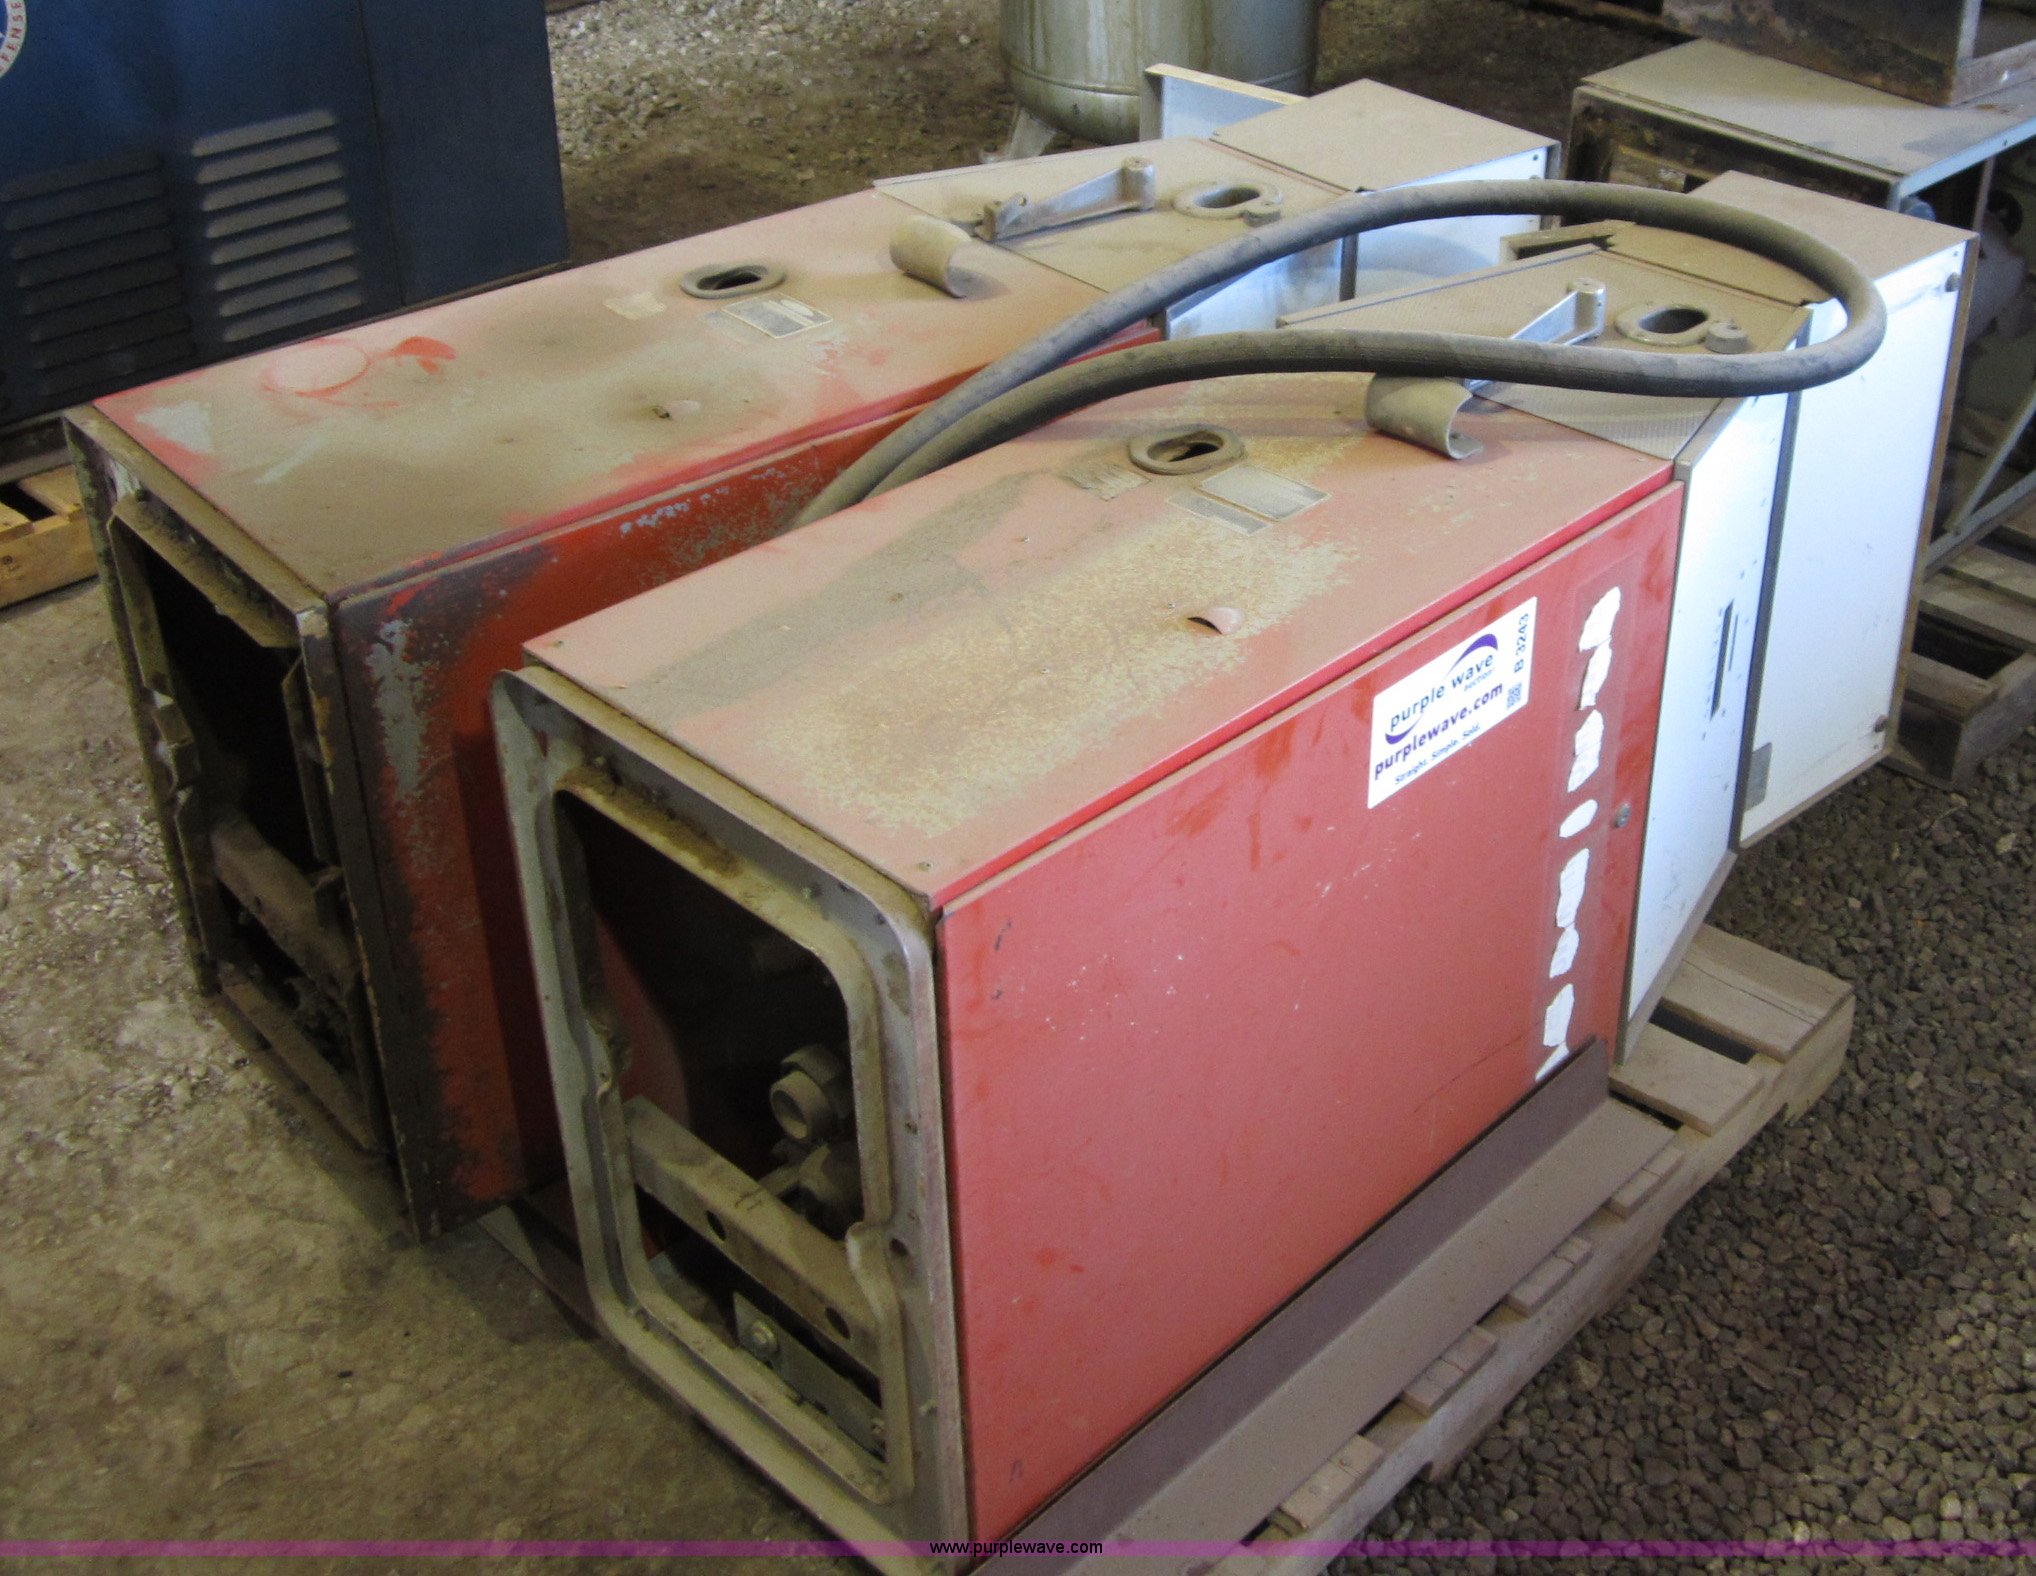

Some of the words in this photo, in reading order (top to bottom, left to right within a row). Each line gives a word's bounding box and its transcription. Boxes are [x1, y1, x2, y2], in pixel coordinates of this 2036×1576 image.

[1515, 613, 1529, 656] 3243
[1390, 685, 1445, 732] purple
[1451, 654, 1493, 689] wave
[1513, 658, 1525, 673] B
[1374, 683, 1503, 781] purplewave.com
